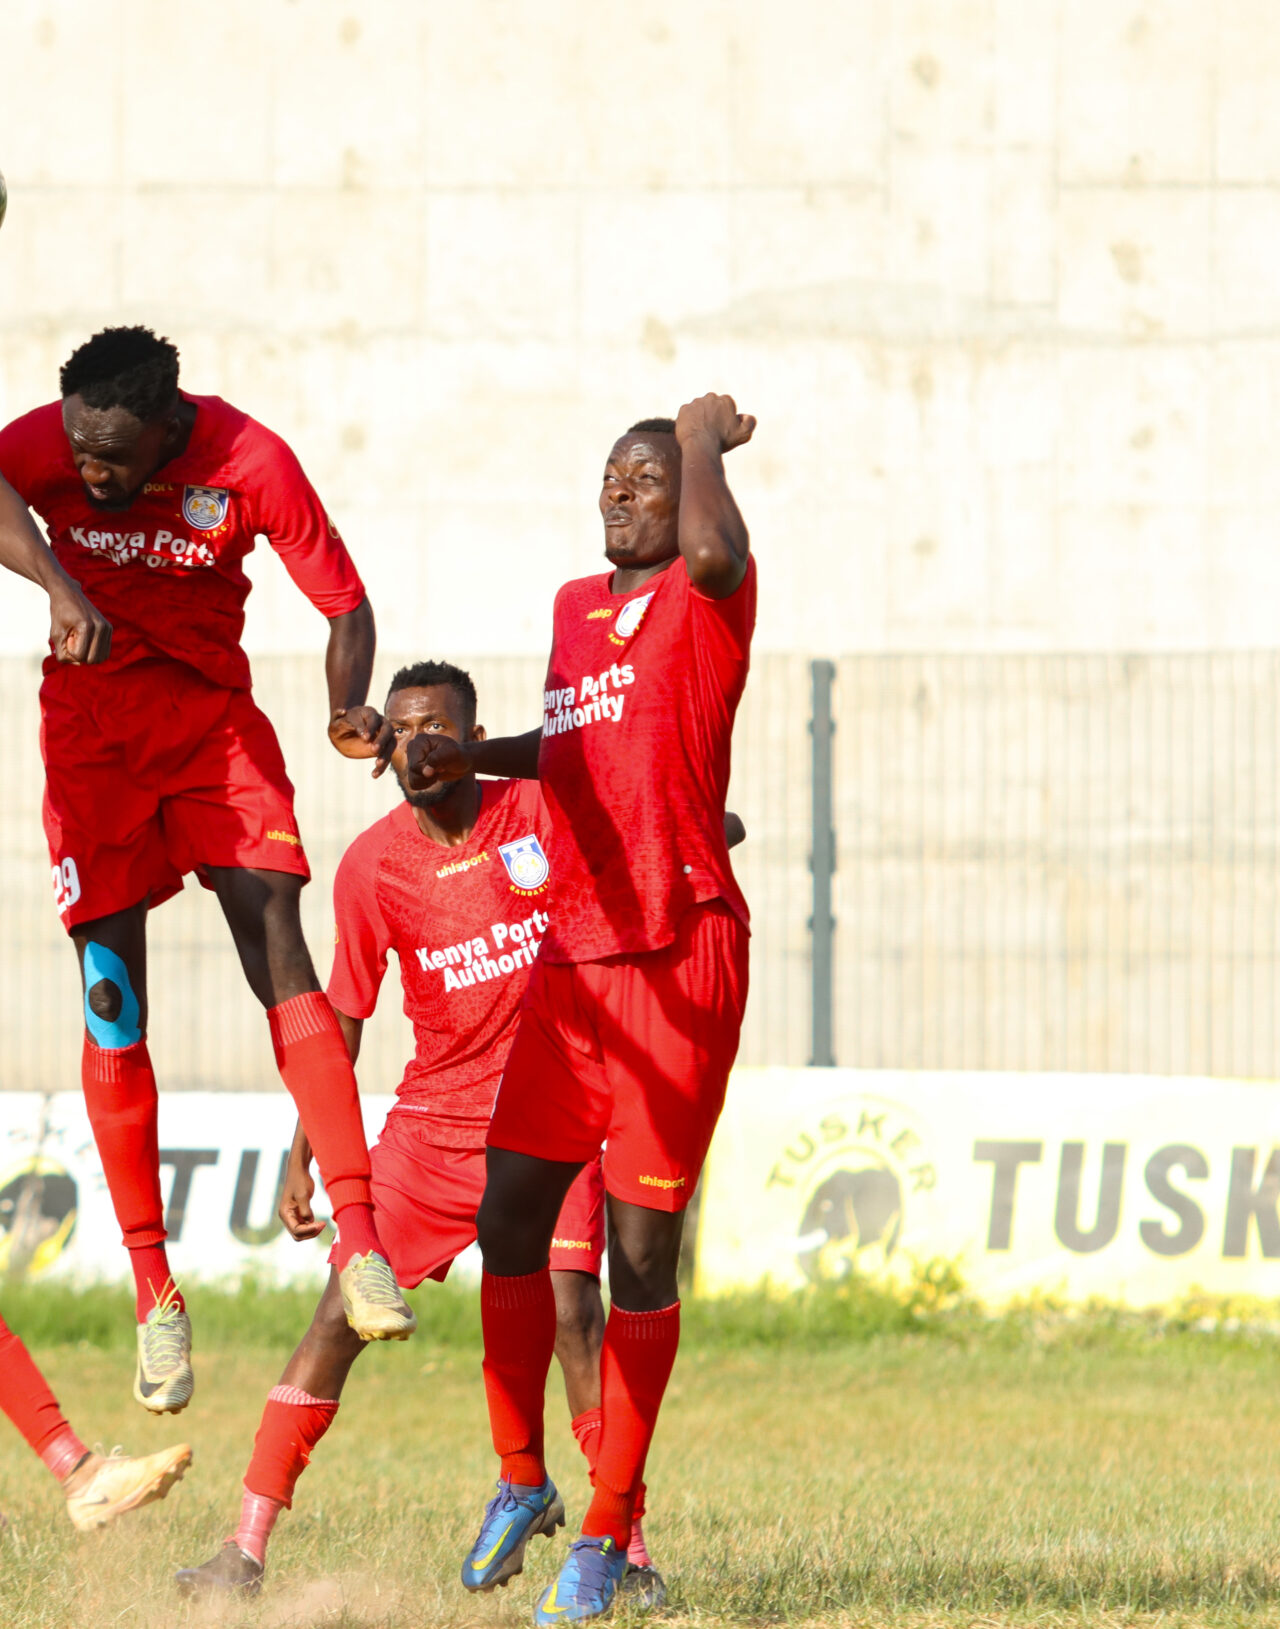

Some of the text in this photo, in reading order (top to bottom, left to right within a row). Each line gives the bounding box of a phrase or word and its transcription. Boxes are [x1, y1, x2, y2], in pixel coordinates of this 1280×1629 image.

[70, 526, 146, 551] Kenya
[544, 663, 636, 715] enya Ports
[541, 692, 625, 740] Authority
[51, 856, 81, 916] 29
[436, 850, 490, 879] uhlsport
[415, 936, 489, 972] Kenya
[443, 937, 542, 993] Authorit
[765, 1110, 937, 1193] TUSKER
[638, 1175, 685, 1190] uhlsport
[973, 1140, 1280, 1260] TUSK
[551, 1237, 592, 1251] hlsport
